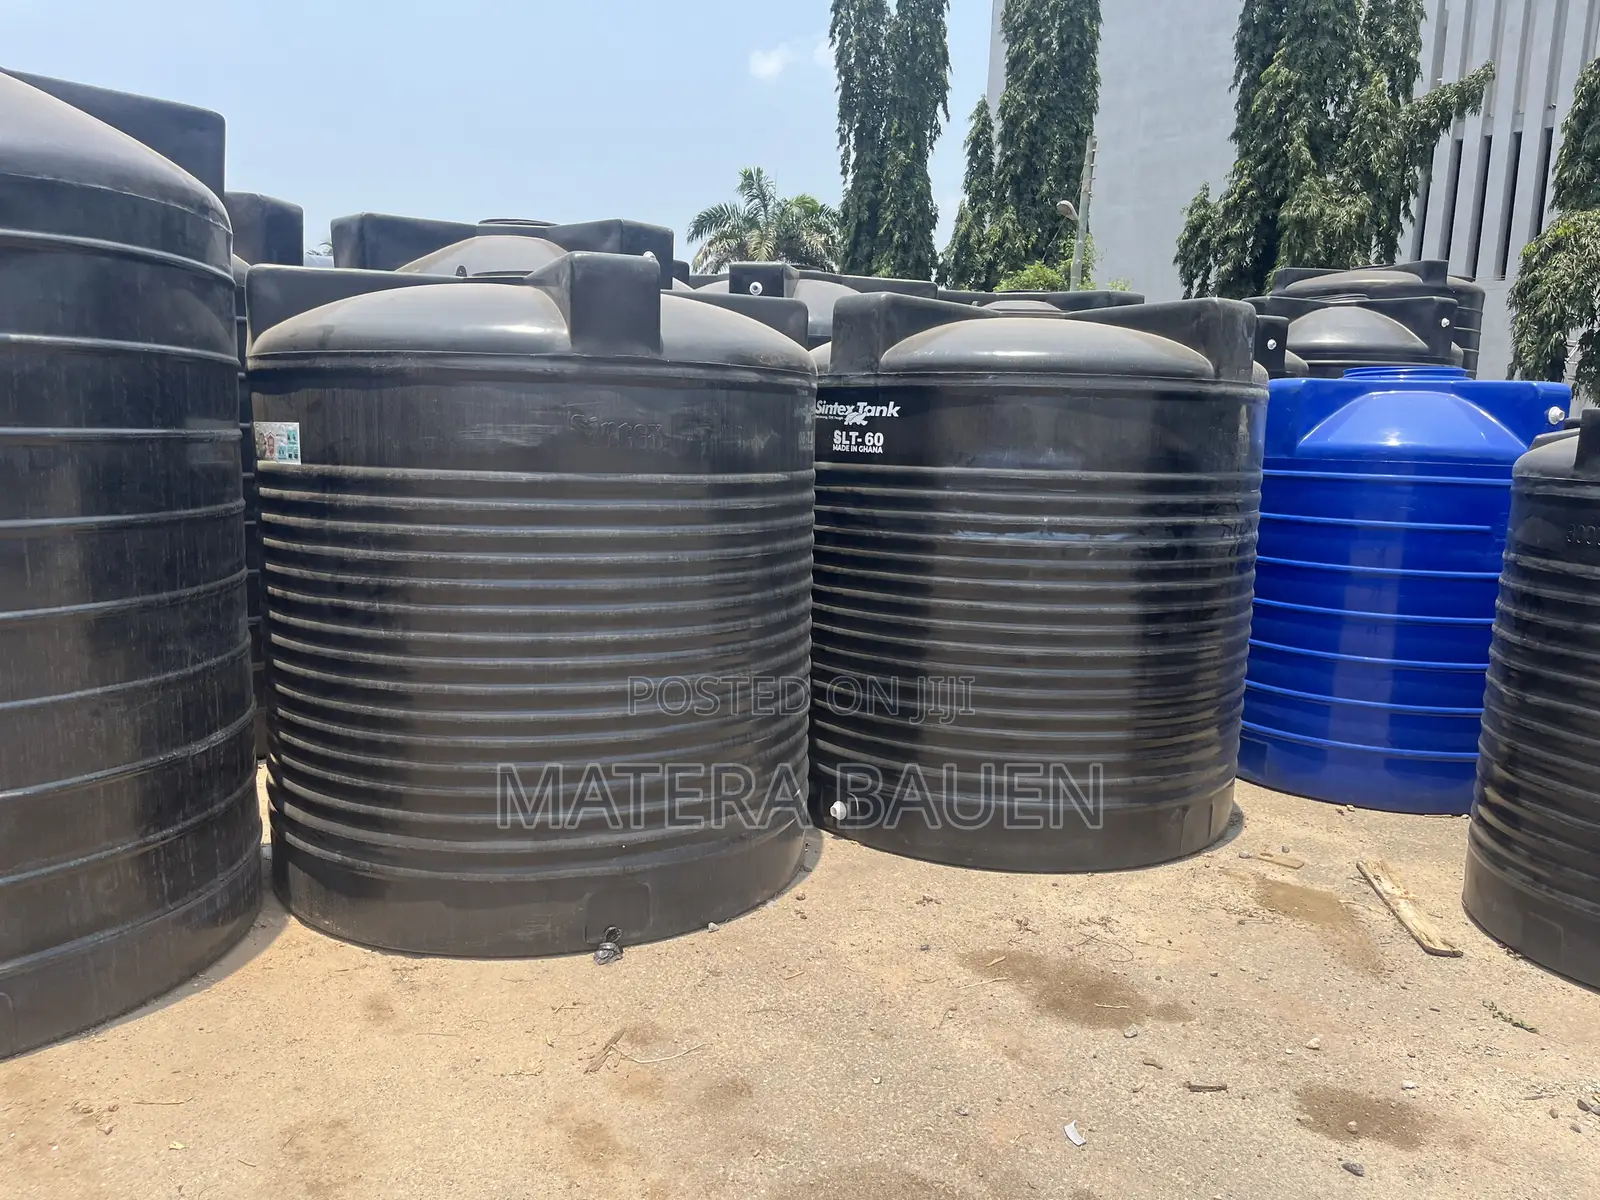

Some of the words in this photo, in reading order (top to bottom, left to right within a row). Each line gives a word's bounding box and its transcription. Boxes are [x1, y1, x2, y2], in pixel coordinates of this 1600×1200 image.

[815, 400, 855, 416] Sintex
[857, 401, 901, 417] Tank
[832, 444, 850, 452] MADE
[850, 445, 858, 453] IN
[859, 445, 883, 454] GHANA
